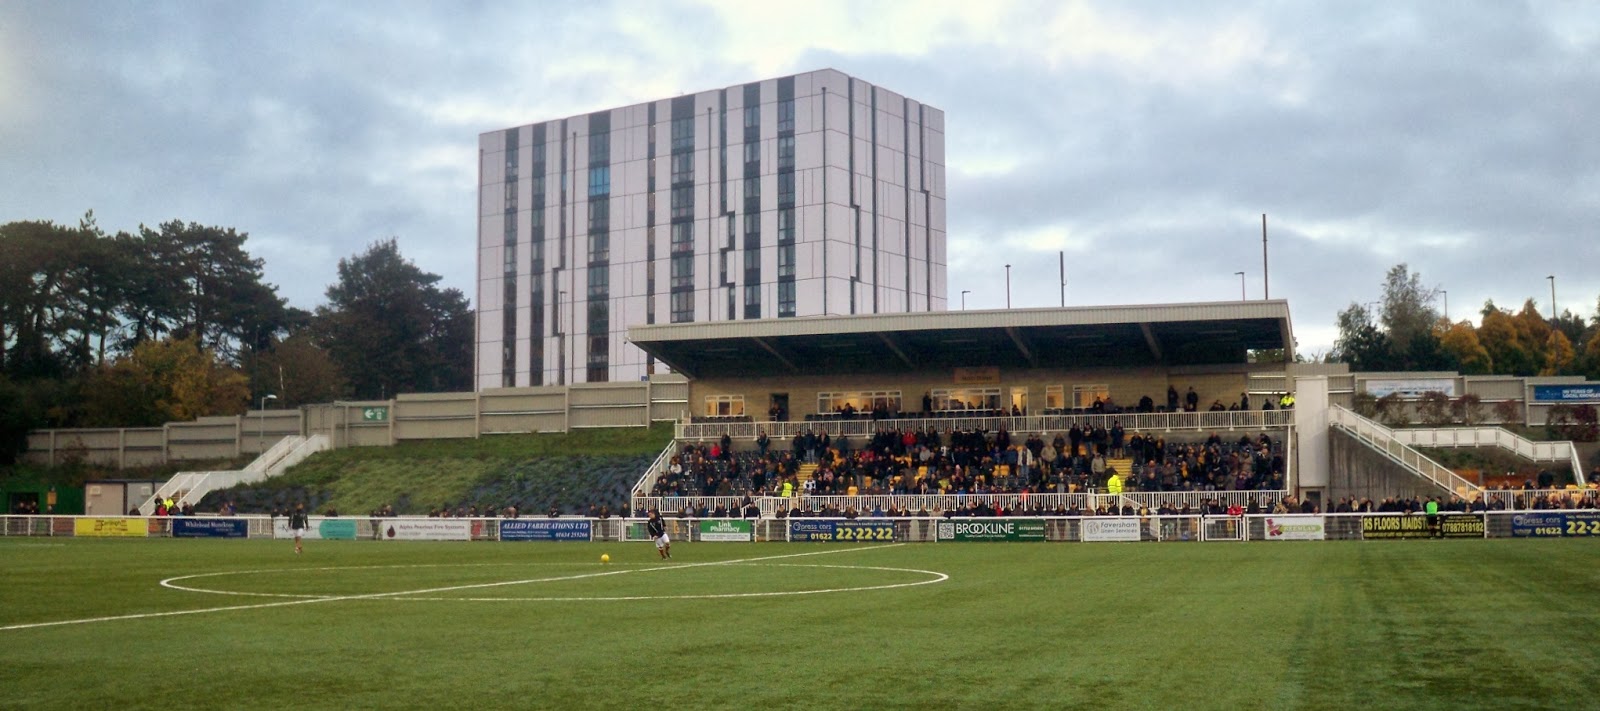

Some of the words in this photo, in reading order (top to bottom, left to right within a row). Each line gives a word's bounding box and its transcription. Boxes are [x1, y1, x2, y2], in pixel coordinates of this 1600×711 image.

[956, 523, 1014, 534] BROOKLINE
[1364, 517, 1372, 530] RS
[1374, 517, 1400, 530] FLOORS
[1535, 527, 1562, 535] 01622
